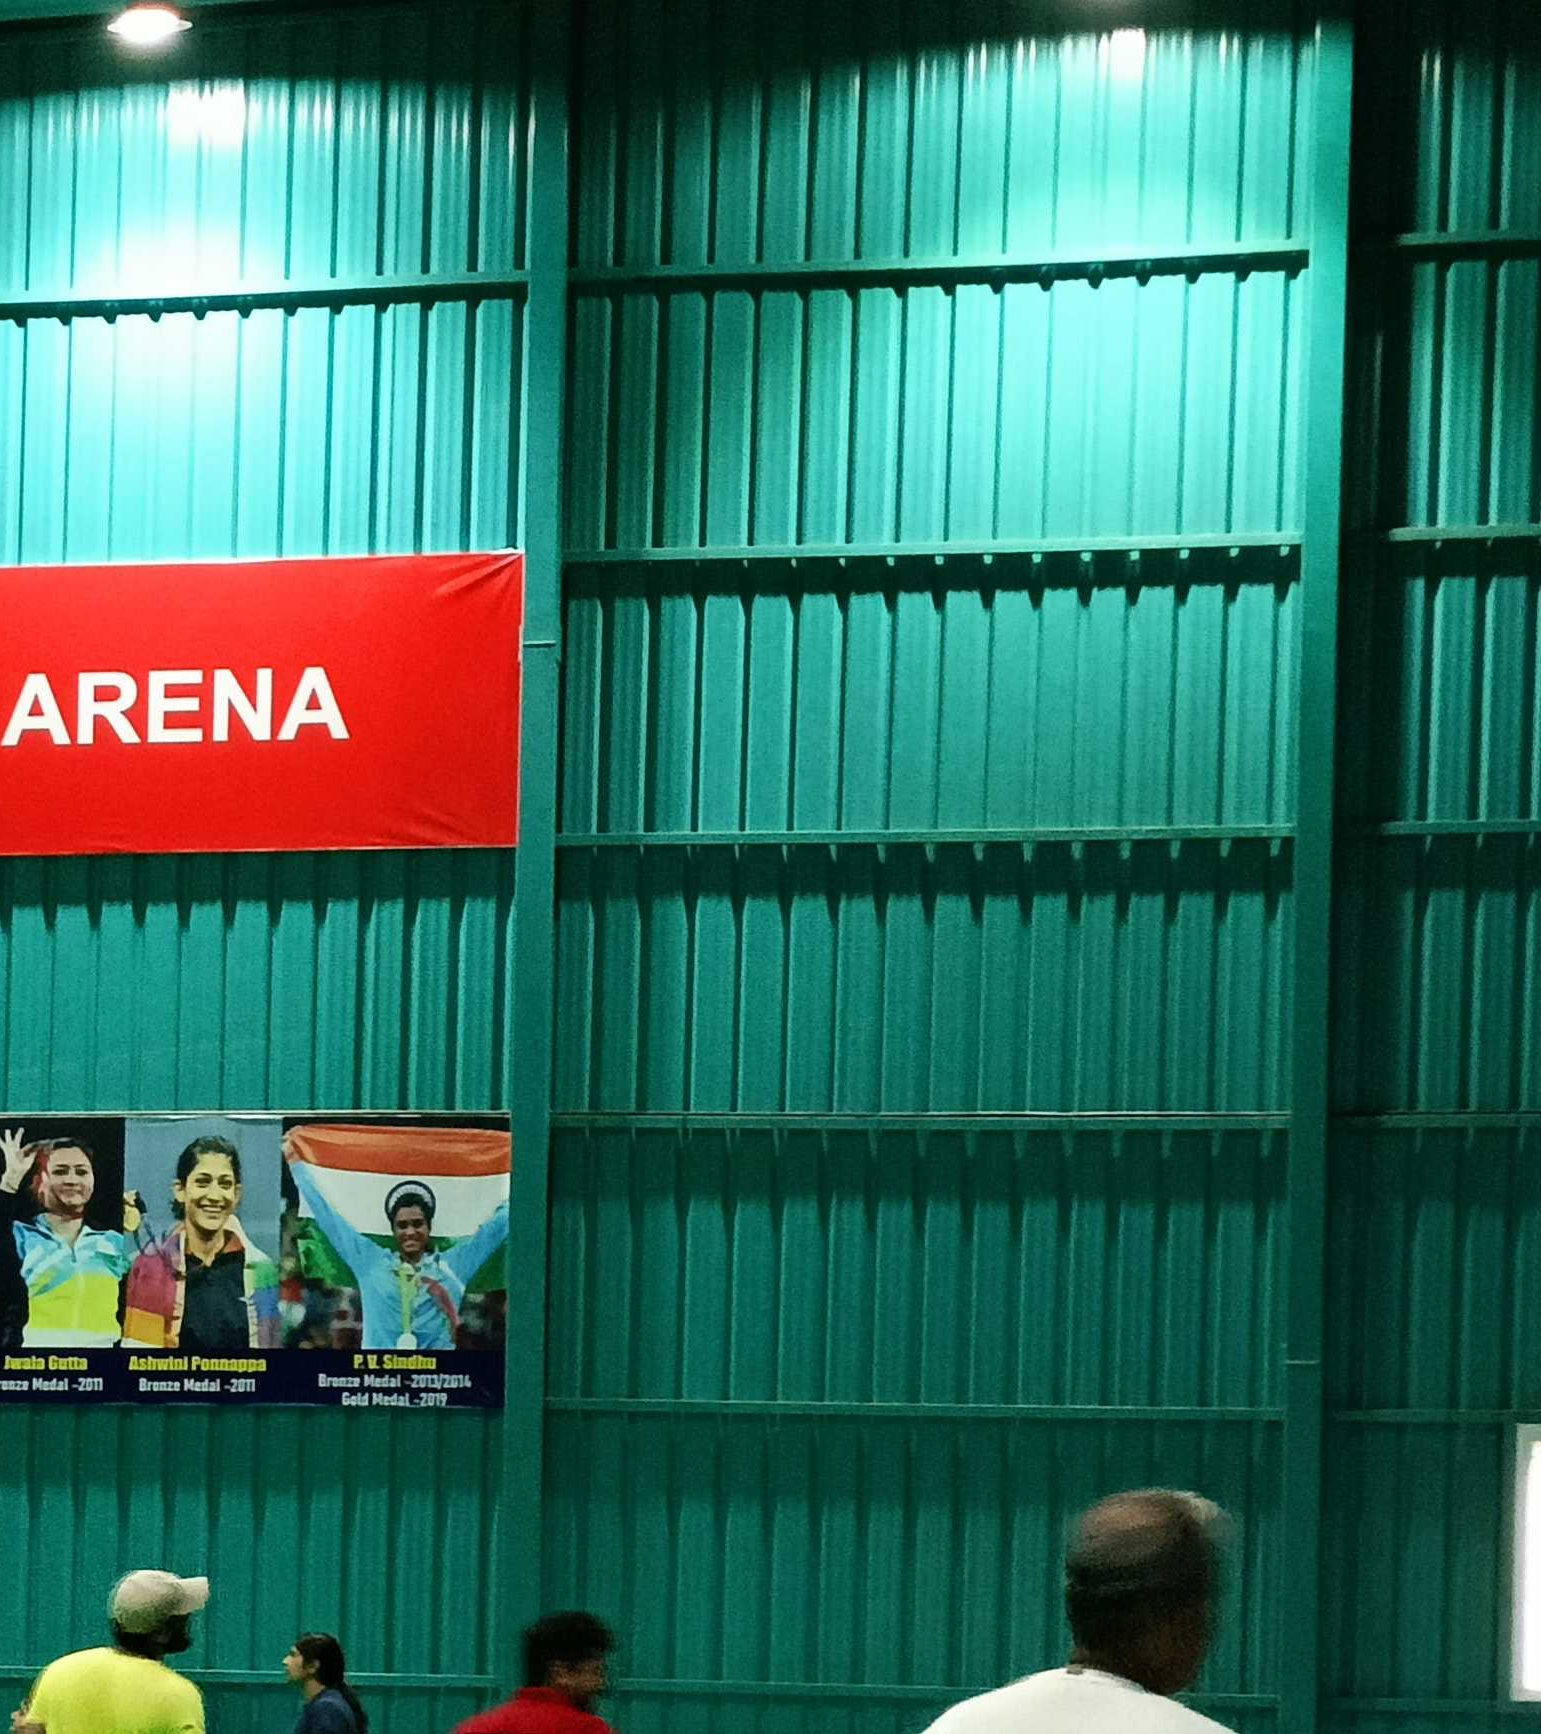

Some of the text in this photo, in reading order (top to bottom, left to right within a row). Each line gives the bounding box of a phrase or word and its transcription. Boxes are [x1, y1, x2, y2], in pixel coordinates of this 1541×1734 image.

[0, 666, 351, 747] ARENA
[128, 1355, 188, 1371] Ashwini
[383, 1354, 437, 1370] Sindhu
[32, 1377, 69, 1391] Medal
[139, 1377, 180, 1392] Bronze
[183, 1378, 221, 1392] Medal
[318, 1373, 360, 1387] Bronze
[364, 1374, 401, 1388] Medal
[341, 1392, 369, 1406] Gold
[372, 1392, 410, 1407] Medal
